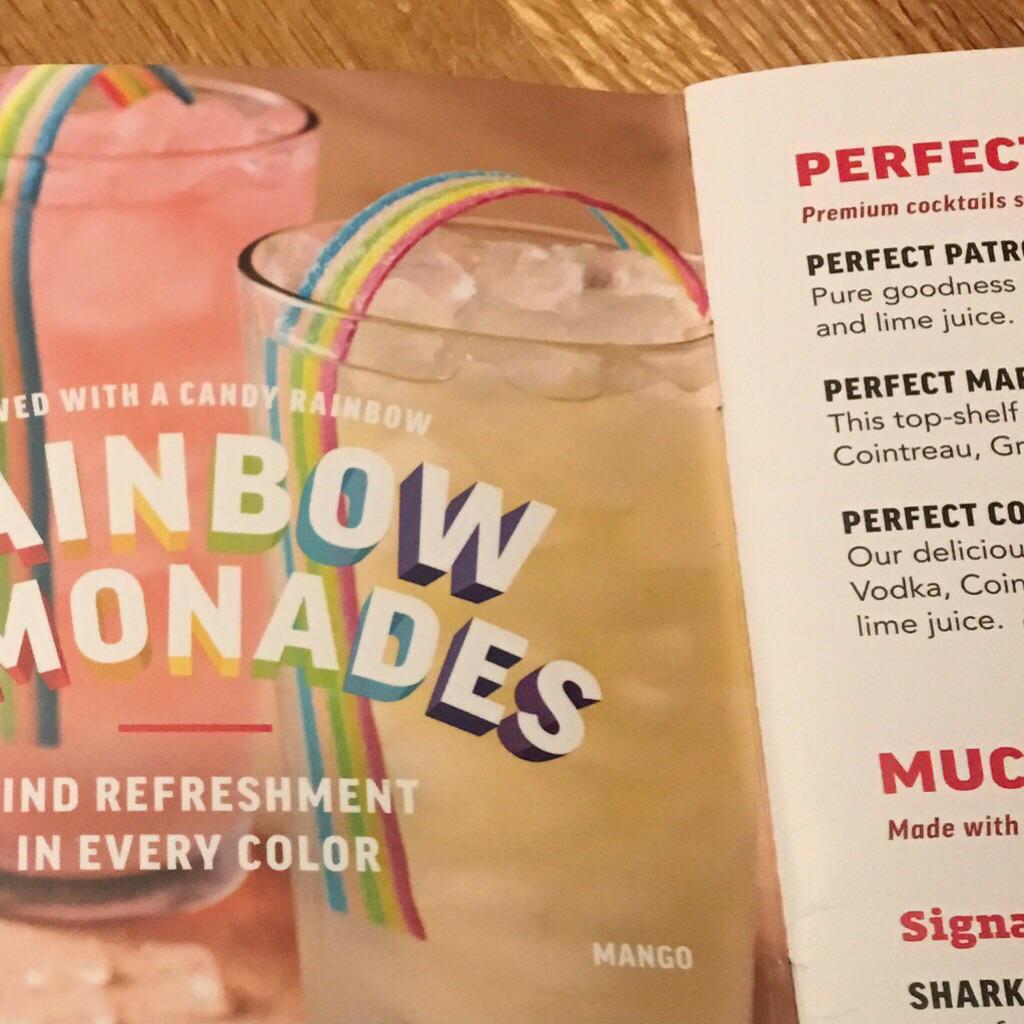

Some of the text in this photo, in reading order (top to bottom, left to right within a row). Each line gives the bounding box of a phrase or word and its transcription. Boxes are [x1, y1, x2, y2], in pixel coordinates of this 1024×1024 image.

[795, 136, 1024, 187] PERFEC
[802, 201, 899, 224] Premium
[906, 191, 1007, 215] cocktails
[806, 239, 1024, 276] PERFECT PATR
[811, 276, 1016, 307] Pure goodness
[816, 308, 1015, 337] and lime juice.
[823, 371, 955, 402] PERFECT
[59, 383, 140, 412] WITH
[150, 381, 170, 406] A
[179, 381, 279, 410] CANDY
[289, 387, 434, 436] RAINBOW
[827, 401, 1019, 433] This top-shelf
[833, 443, 980, 467] Cointreau,
[842, 500, 1024, 534] PERFECT CO
[847, 545, 902, 567] Our
[849, 576, 950, 601] Vodka,
[857, 610, 1004, 639] lime juice.
[879, 746, 1024, 794] MUC
[96, 776, 420, 814] REFRESHMENT
[888, 814, 1019, 840] Made with
[17, 834, 382, 873] IN EVERY COLOR
[593, 942, 694, 970] MANGO
[908, 978, 1024, 1010] SHARK
